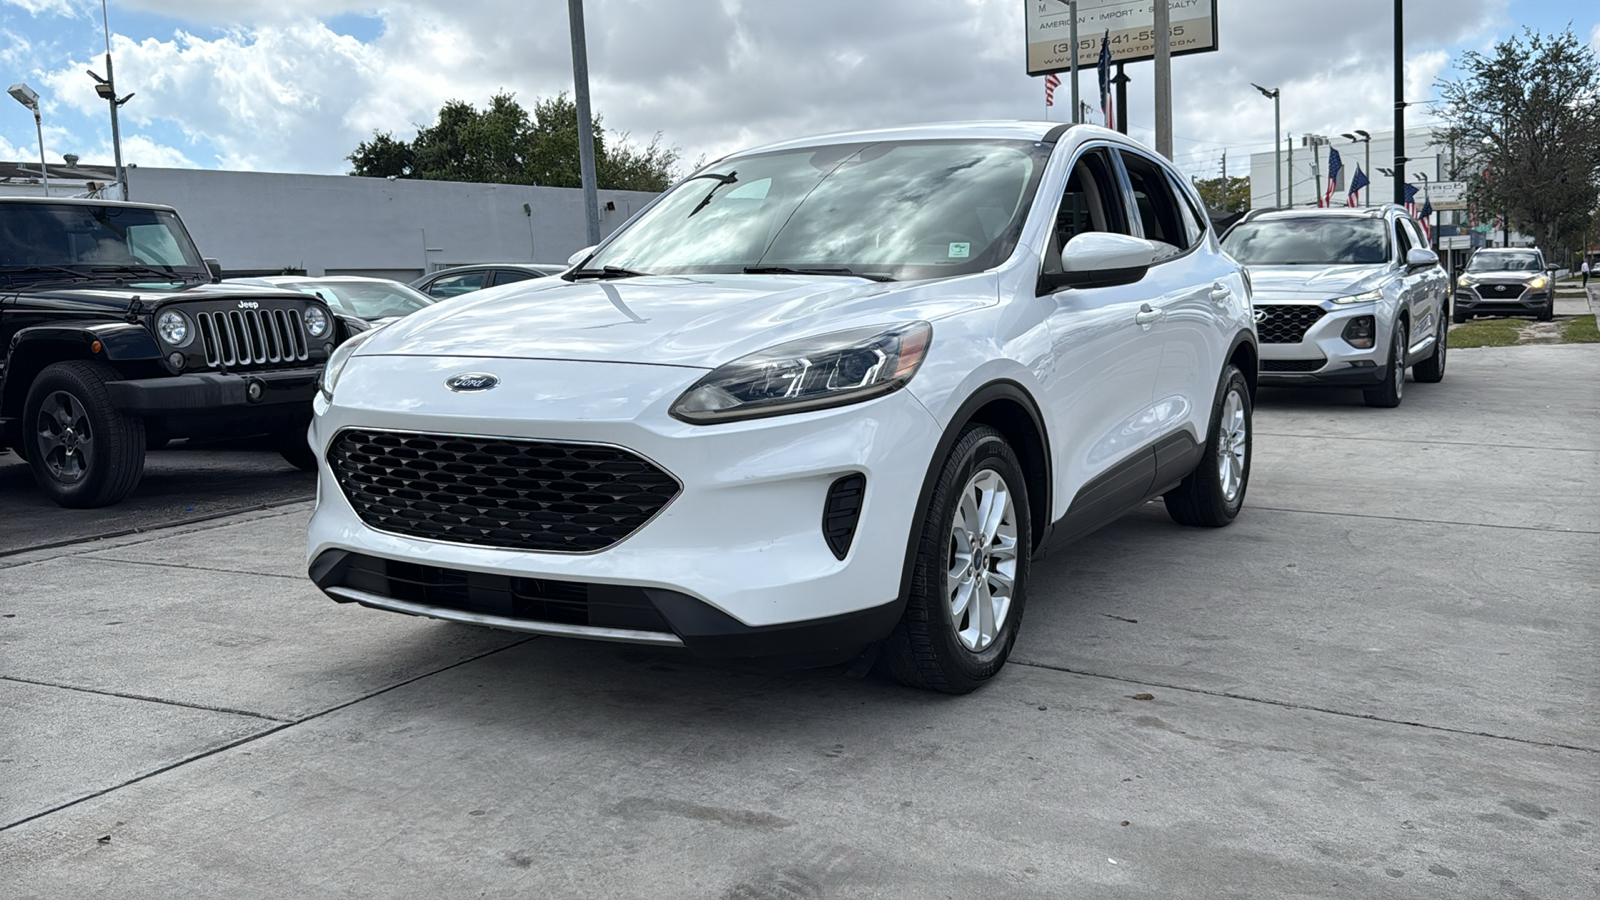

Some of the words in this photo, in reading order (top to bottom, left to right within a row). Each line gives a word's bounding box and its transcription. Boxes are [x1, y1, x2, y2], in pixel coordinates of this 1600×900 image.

[1040, 17, 1086, 30] AMERICN
[1099, 9, 1134, 21] IMPORT
[1148, 0, 1198, 13] SCIALTY
[237, 300, 259, 309] Jeep
[453, 375, 487, 387] Ford
